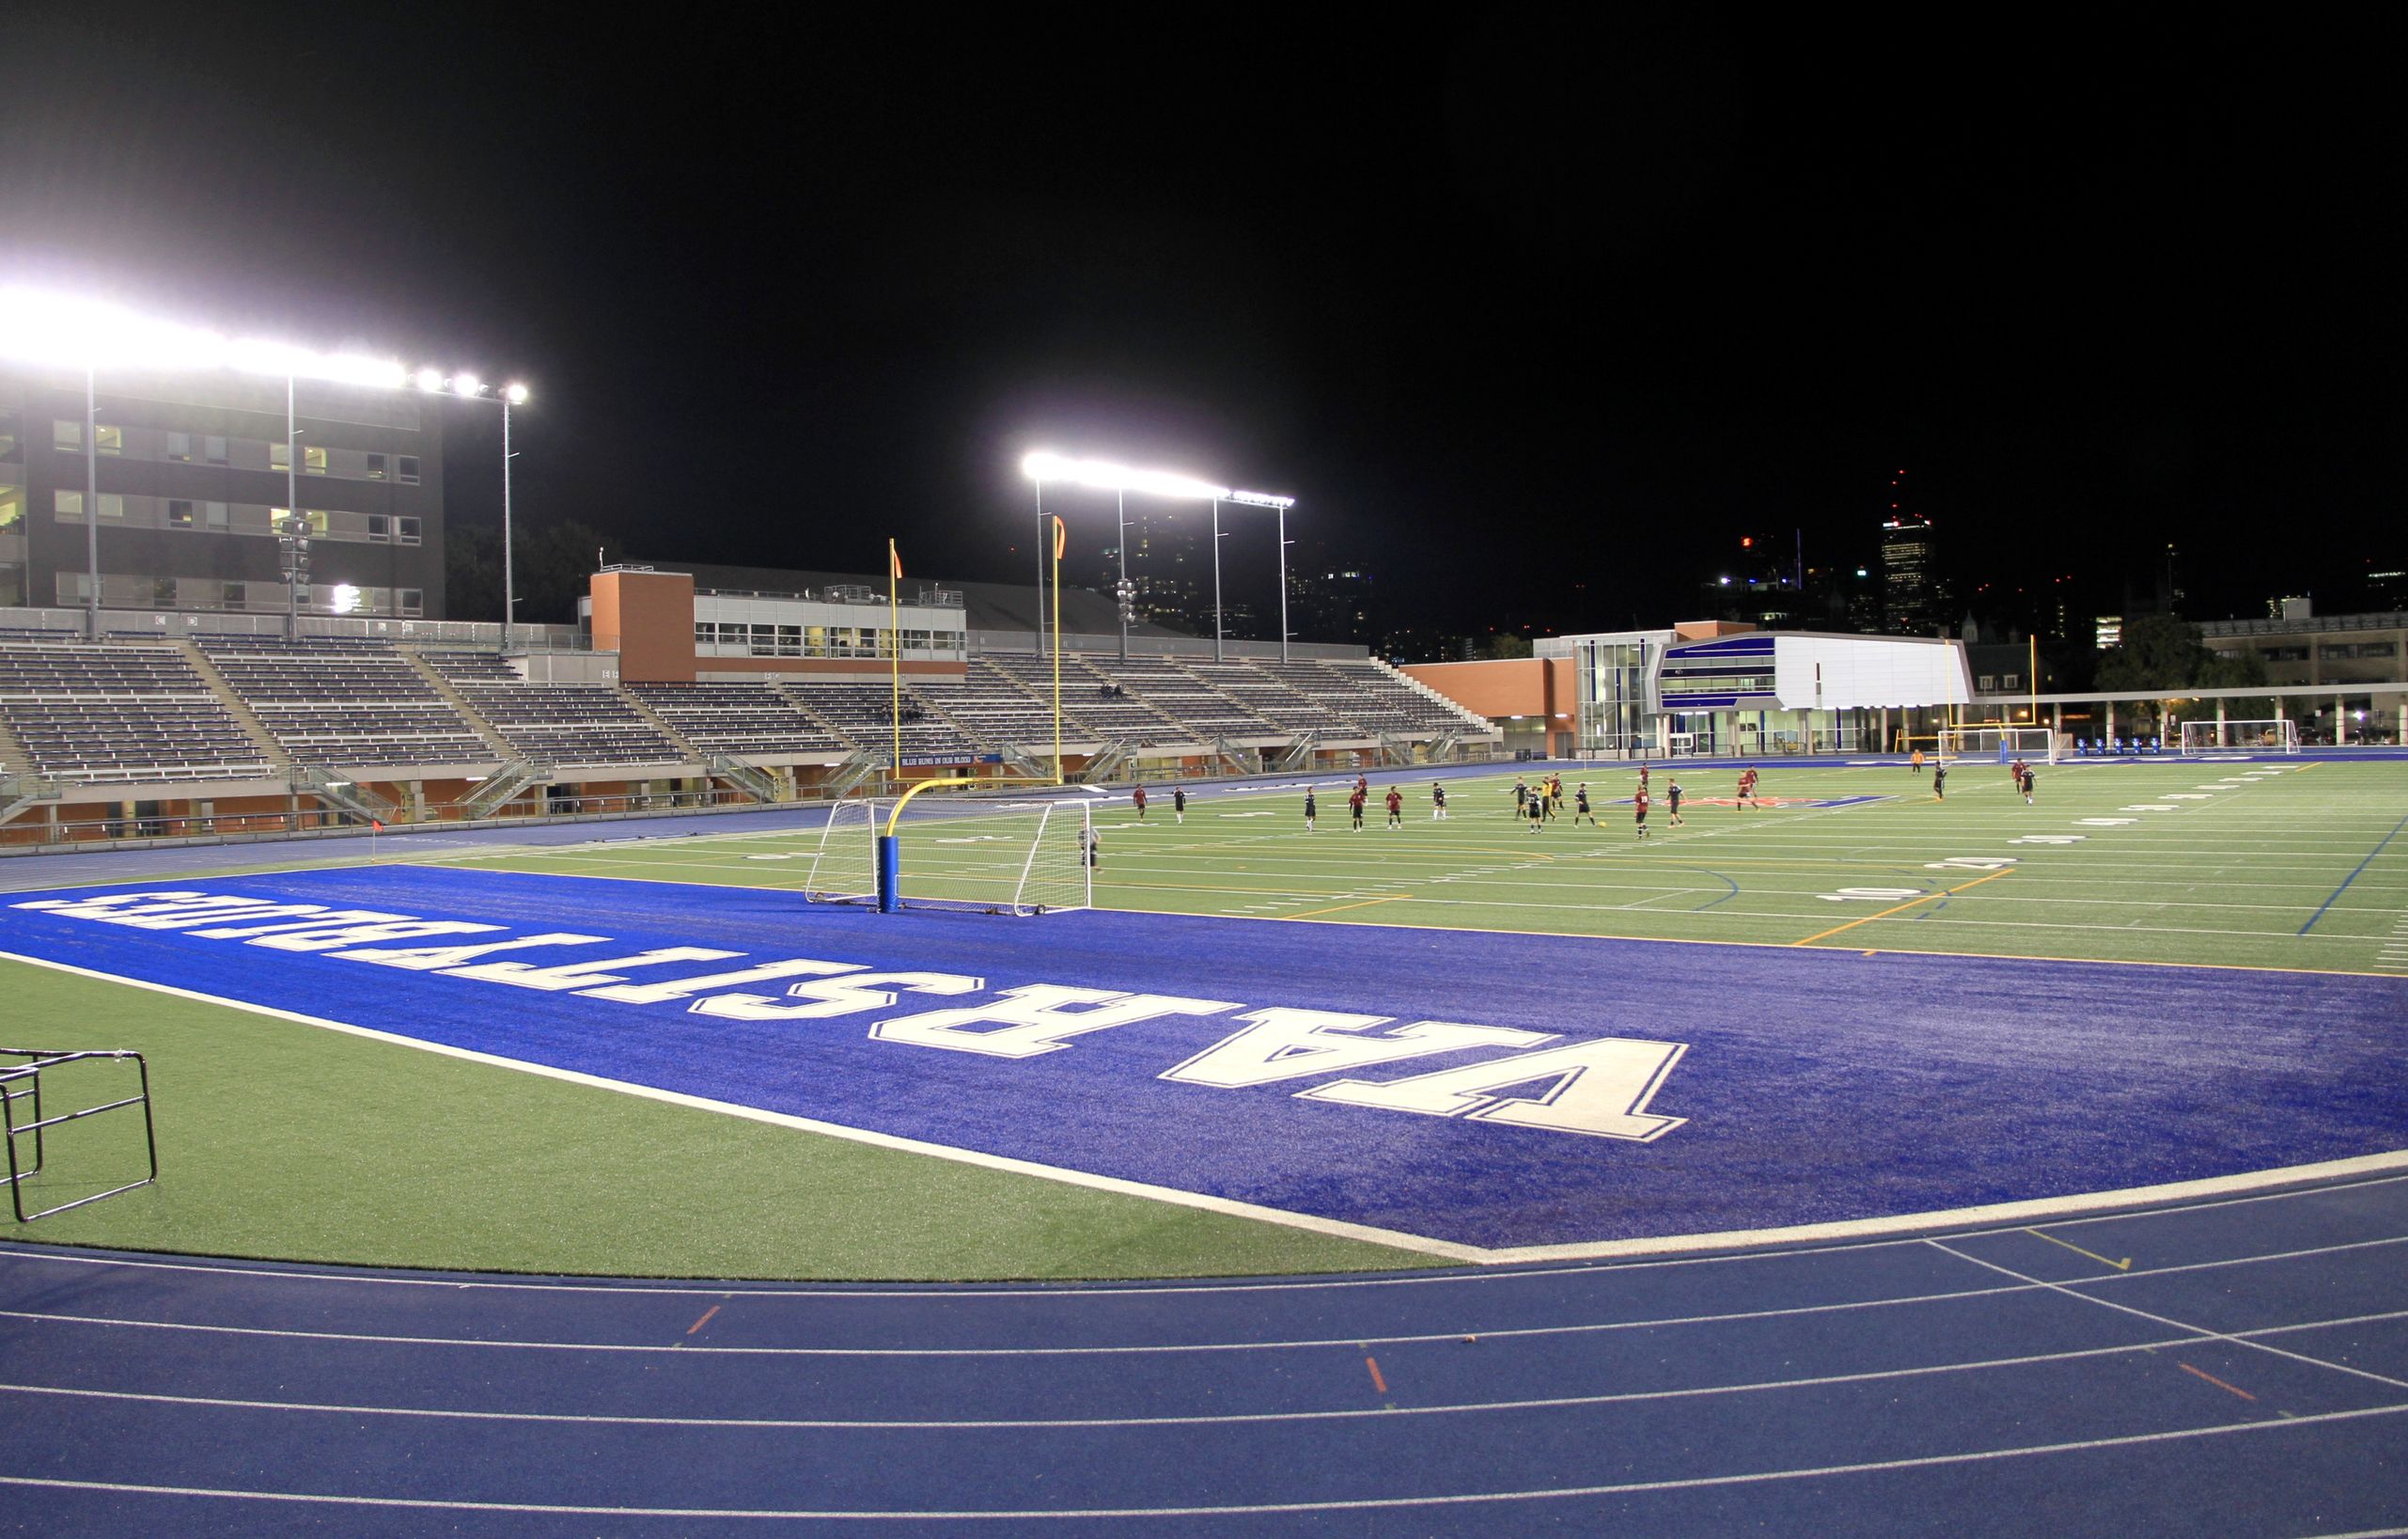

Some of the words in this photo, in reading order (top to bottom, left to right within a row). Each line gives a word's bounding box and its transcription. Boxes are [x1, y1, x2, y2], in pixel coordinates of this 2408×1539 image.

[1923, 856, 2021, 870] 20
[1816, 887, 1926, 902] 10
[8, 890, 509, 952] BLUES
[323, 932, 1691, 1144] VARSITY
